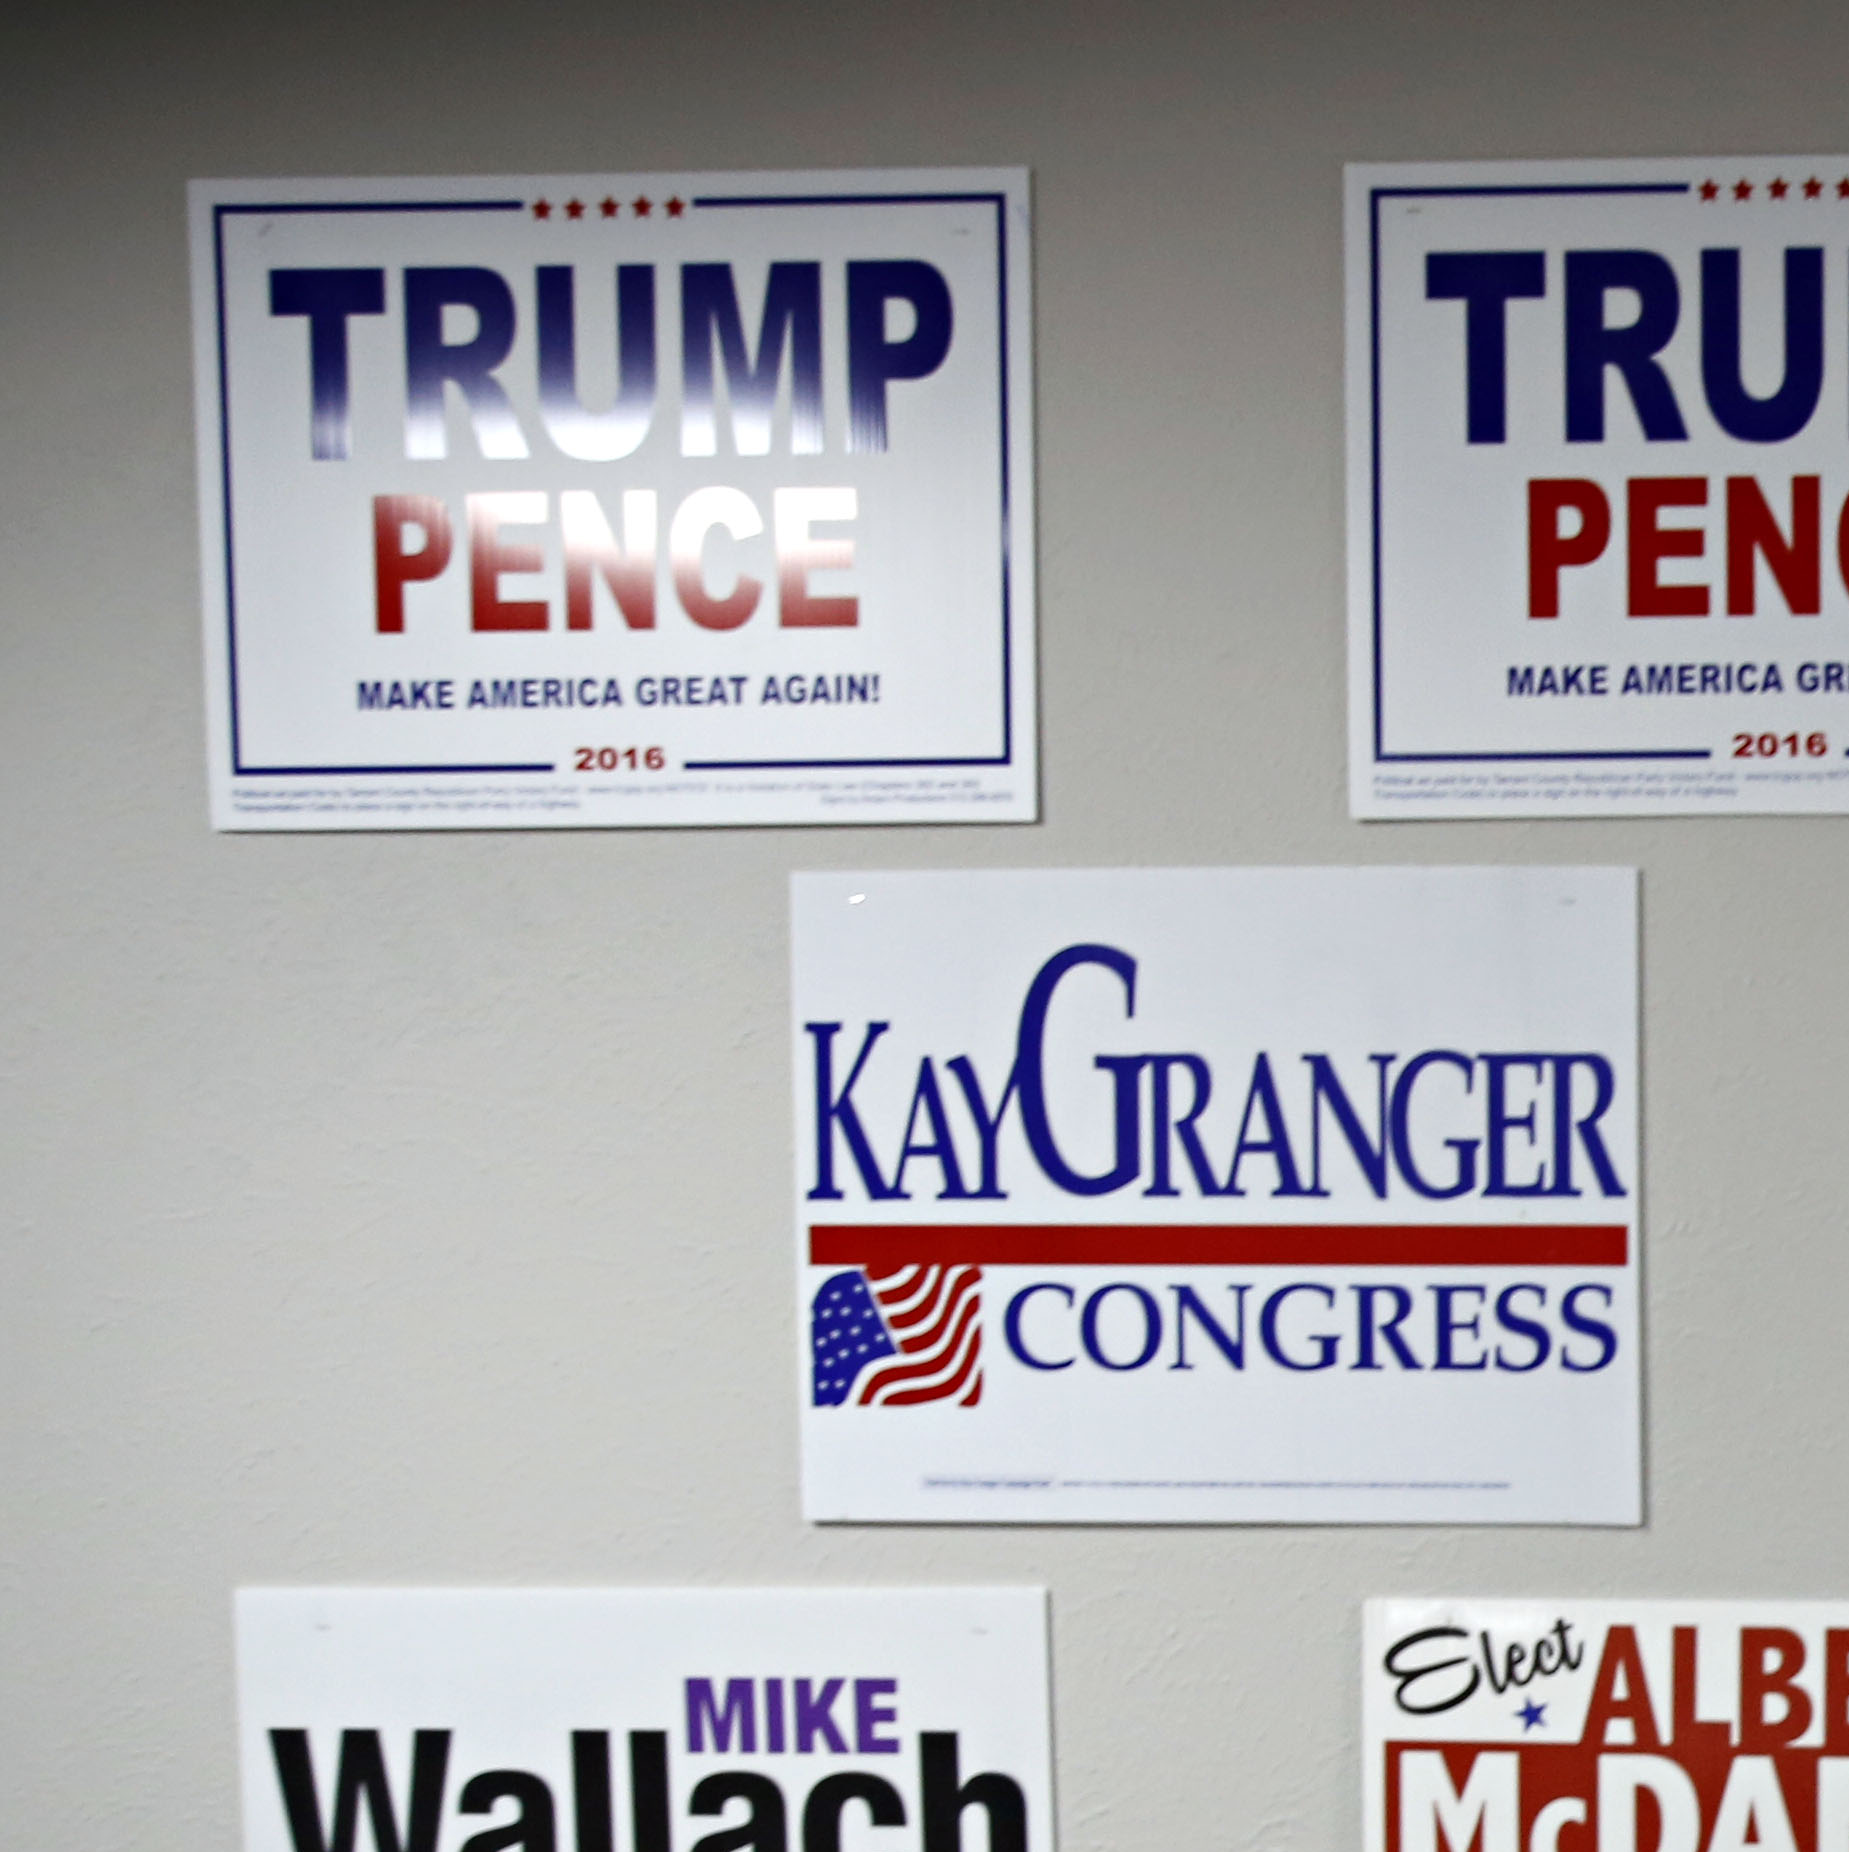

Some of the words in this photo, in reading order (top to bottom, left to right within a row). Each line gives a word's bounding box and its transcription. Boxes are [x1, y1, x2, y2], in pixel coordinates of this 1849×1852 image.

[269, 260, 955, 461] TRUMP
[373, 486, 860, 633] PENCE
[358, 680, 455, 711] MAKE
[467, 679, 622, 709] AMERICA
[636, 676, 748, 708] GREAT
[761, 675, 881, 706] AGAIN!
[1508, 666, 1609, 697] MAKE
[1622, 664, 1782, 695] AMERICA
[575, 748, 665, 771] 2016
[1733, 733, 1827, 757] 2016
[1004, 1284, 1617, 1373] CONGRESS
[1384, 1619, 1583, 1714] Elect
[684, 1677, 898, 1754] MIKE
